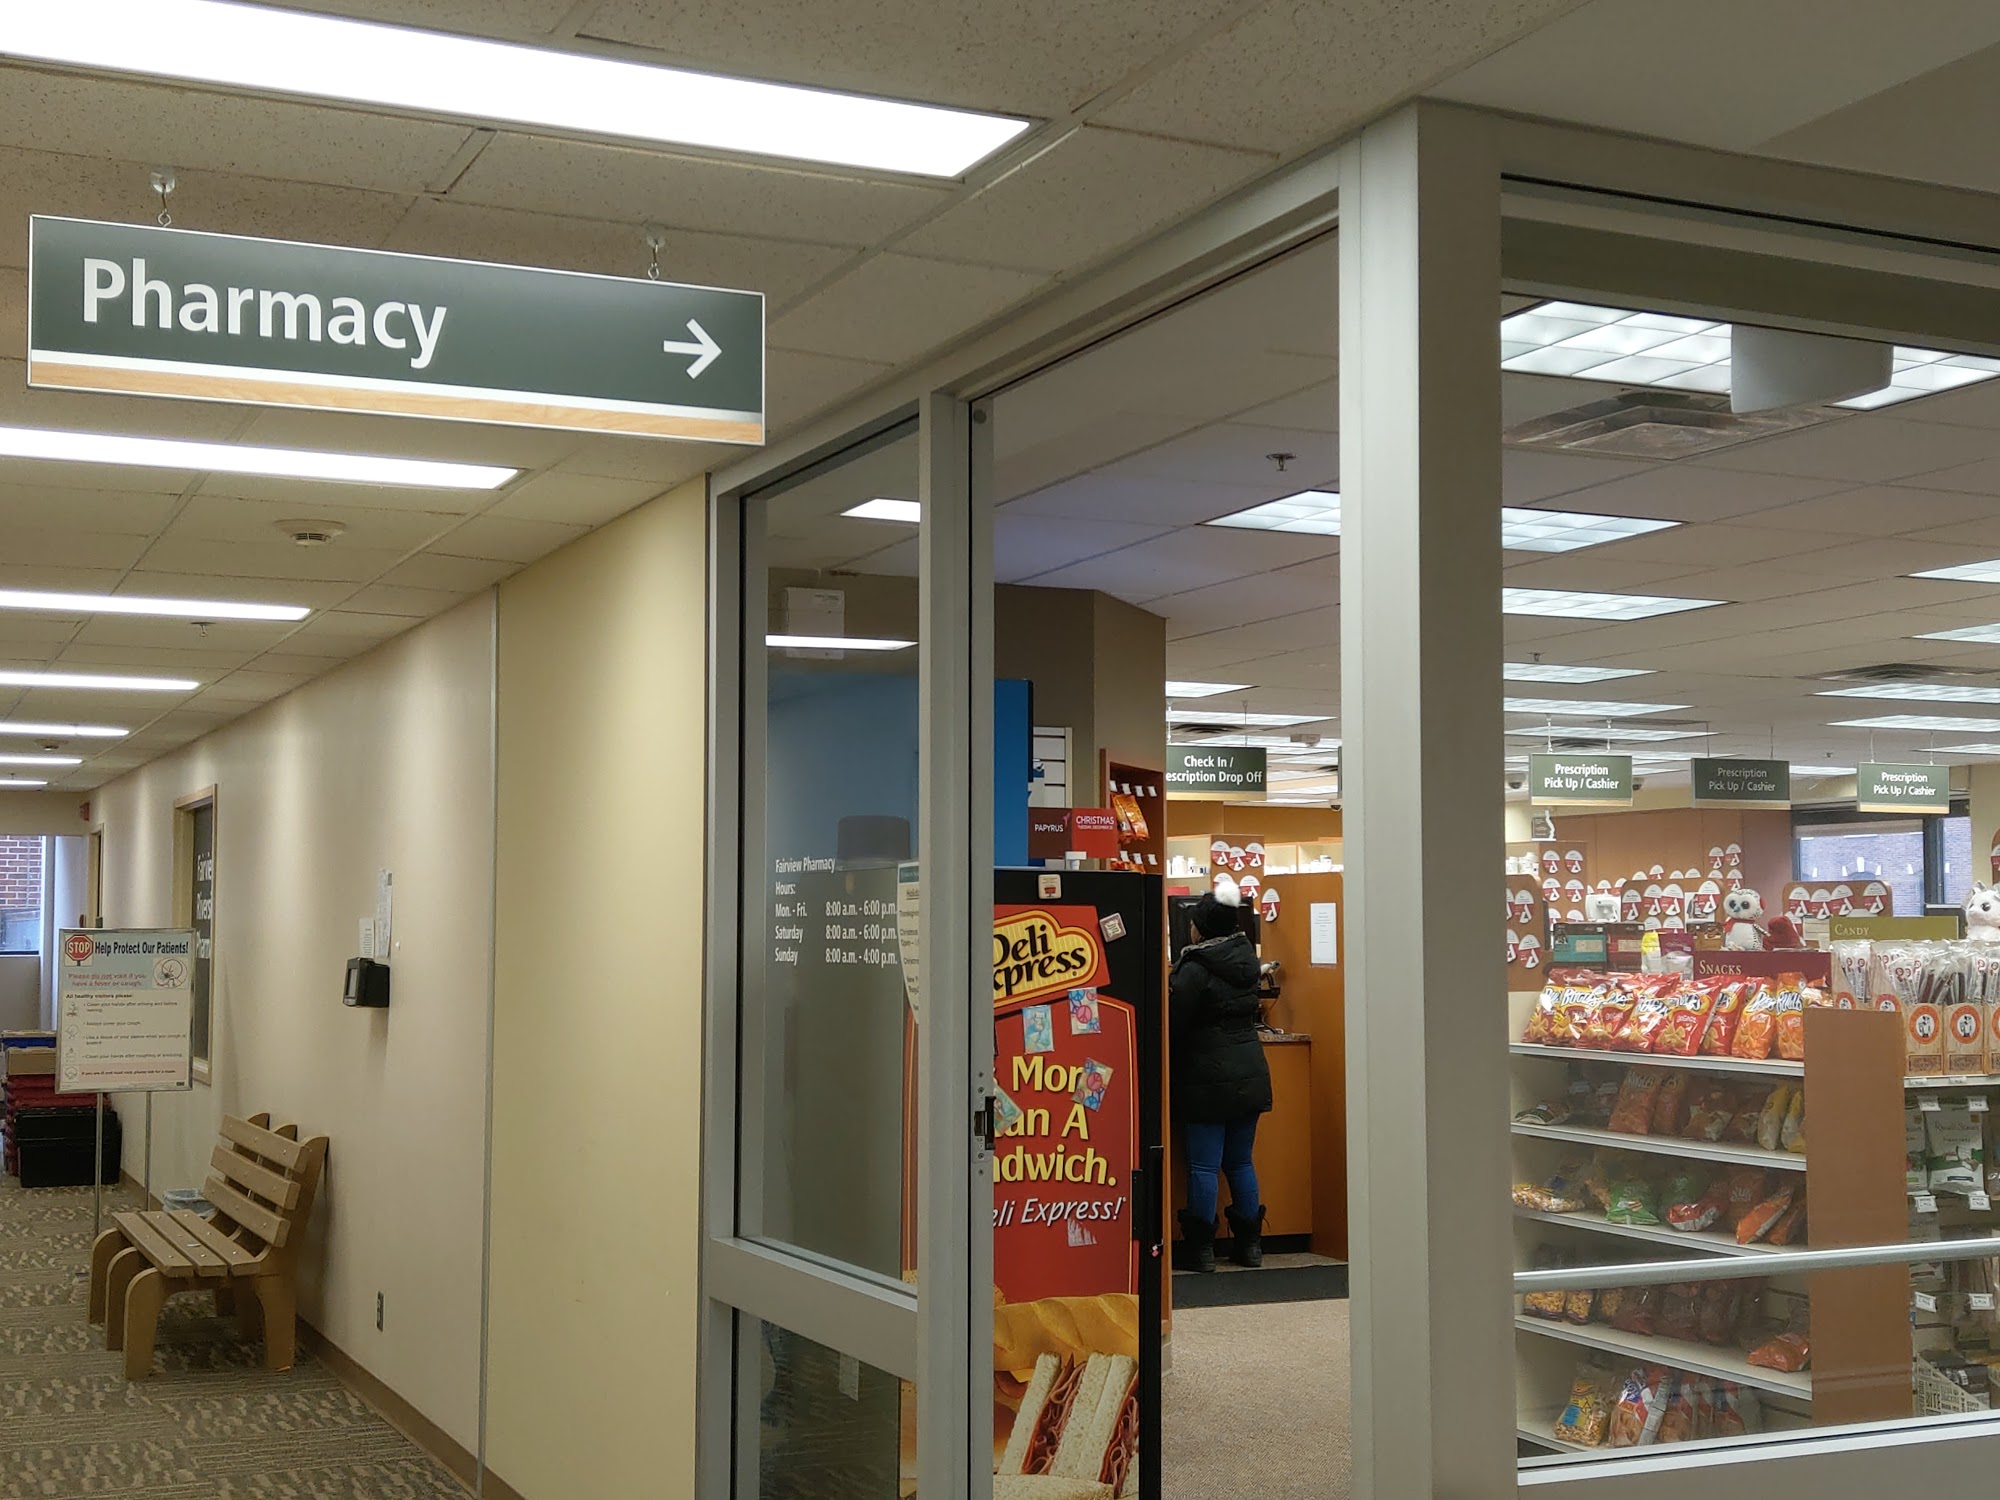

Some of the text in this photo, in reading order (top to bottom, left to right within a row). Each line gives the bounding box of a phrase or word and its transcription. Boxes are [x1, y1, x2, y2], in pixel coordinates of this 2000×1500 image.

[82, 257, 447, 368] Pharmacy
[1184, 755, 1234, 768] Check In /
[1166, 770, 1262, 786] escription Drop Off
[1555, 763, 1609, 778] Prescription
[1717, 767, 1767, 779] Prescription
[1881, 771, 1928, 784] Prescription
[1544, 777, 1564, 788] Pick
[1565, 778, 1578, 791] Up
[1586, 778, 1619, 789] Cashier
[1709, 781, 1725, 790] Pick
[1727, 781, 1739, 793] Up
[1747, 781, 1775, 792] Cashier
[1873, 784, 1889, 795] Pick
[1890, 785, 1902, 797] Up
[1908, 785, 1936, 796] Cashier
[1034, 824, 1064, 832] PAPYRUS
[1076, 816, 1114, 825] CHRISTMAS
[775, 856, 835, 873] Fairview Pharmacy
[775, 882, 796, 895] Hours:
[775, 903, 791, 917] Mon.
[796, 902, 807, 917] Fri.
[826, 901, 841, 916] 8:00
[842, 905, 857, 916] a.m.
[863, 900, 879, 915] 6:00
[881, 902, 897, 919] p.m.
[775, 924, 803, 943] Saturday
[826, 925, 841, 940] 8:00
[842, 928, 857, 940] a.m.
[863, 924, 879, 940] 6:00
[881, 927, 897, 944] p.m.
[69, 941, 90, 953] STOP
[95, 941, 111, 956] Help
[113, 941, 140, 954] Protect
[142, 942, 155, 954] Our
[157, 941, 189, 954] Patients!
[993, 924, 1052, 967] Deli
[775, 947, 798, 966] Sunday
[826, 948, 841, 963] 8:00
[842, 952, 857, 964] a.m.
[863, 948, 879, 964] 4:00
[881, 952, 897, 968] p.m.
[993, 947, 1086, 997] xpress
[1012, 1055, 1084, 1093] Mor
[996, 1103, 1089, 1140] an A
[993, 1144, 1117, 1187] dwich.
[1021, 1197, 1123, 1227] Express!
